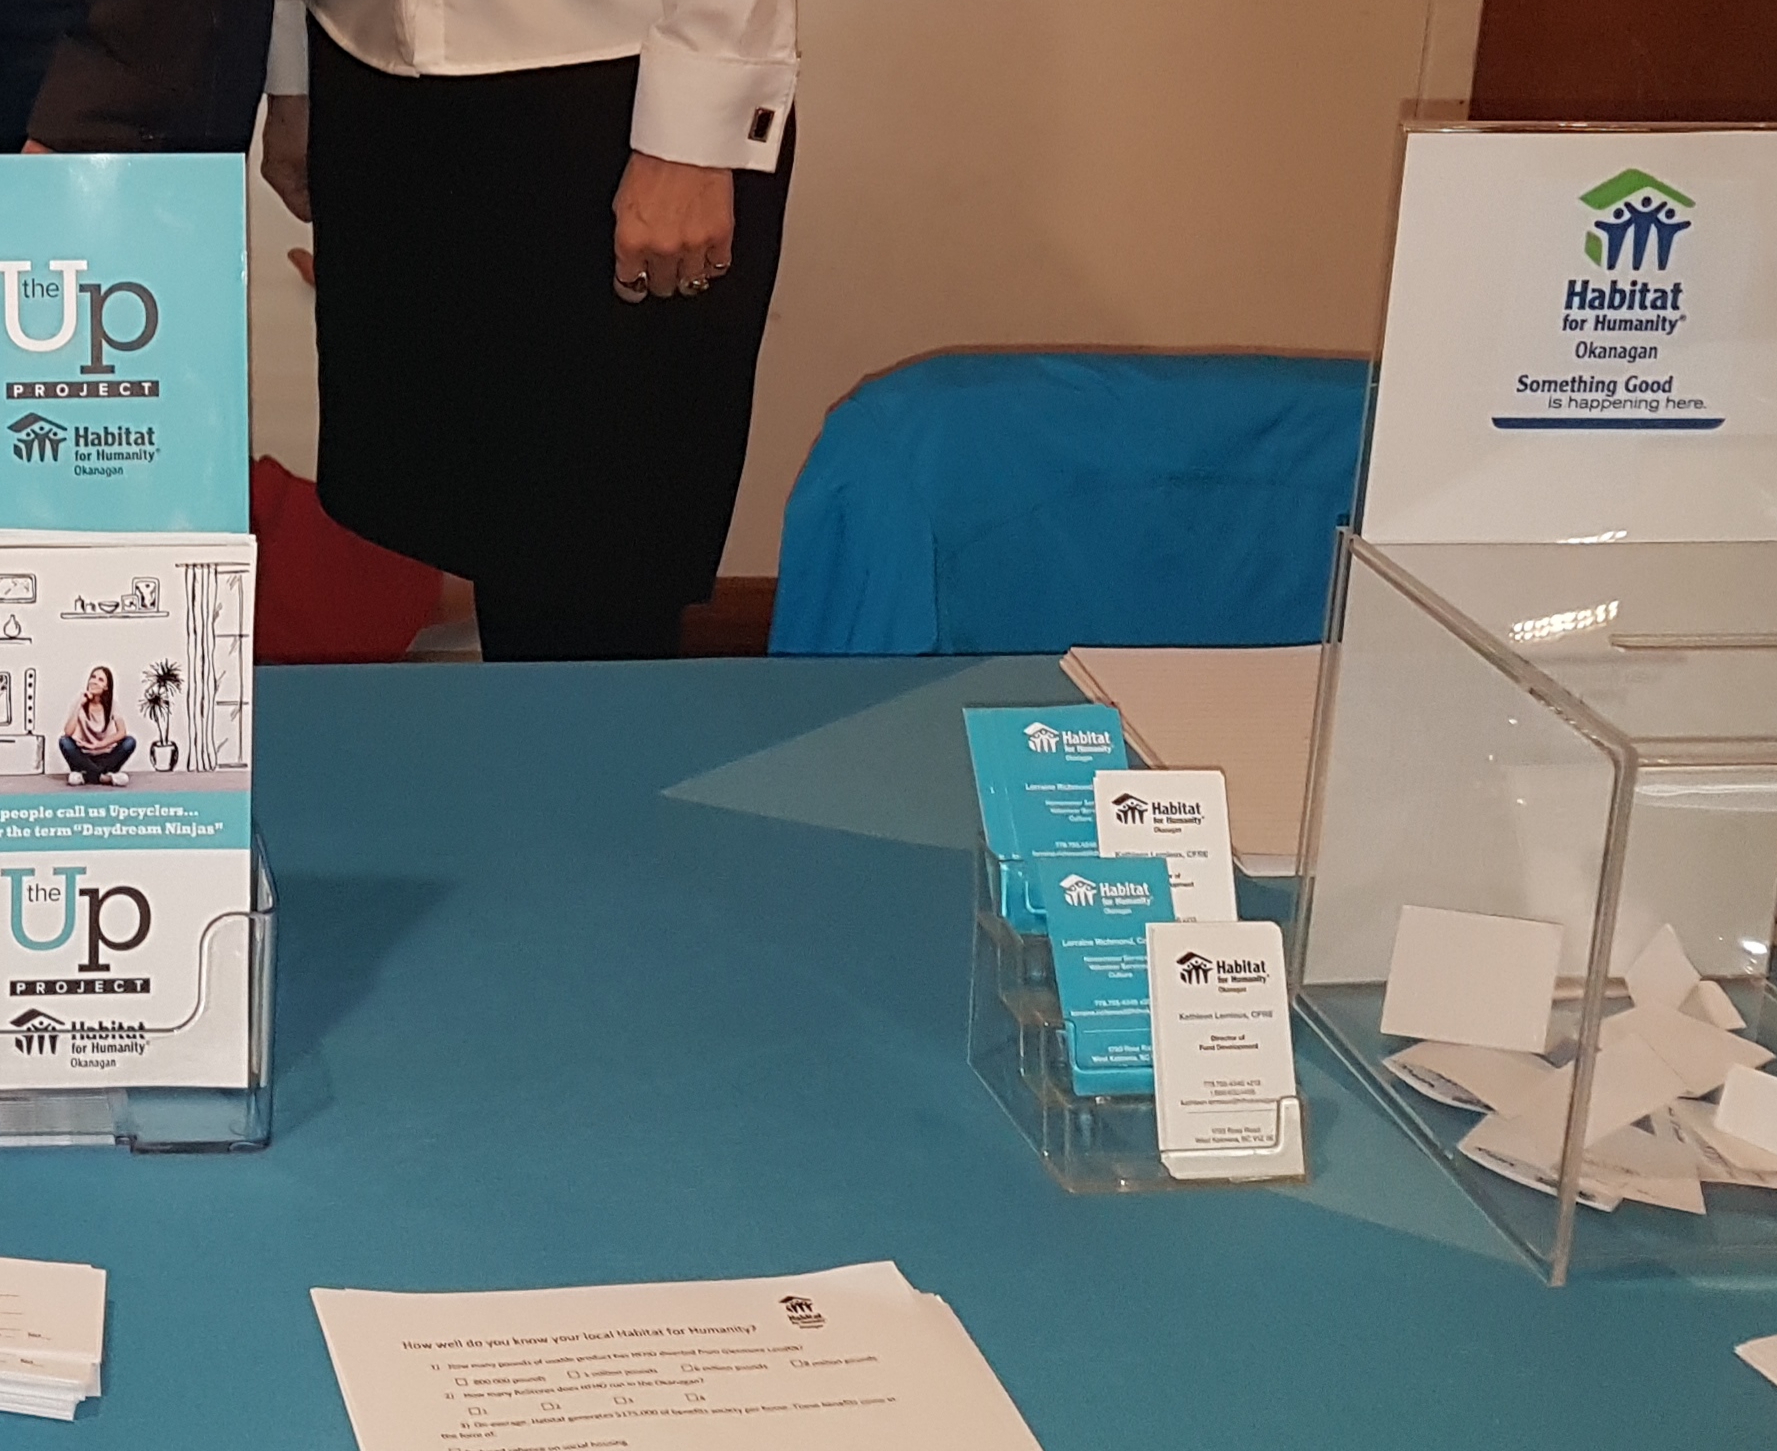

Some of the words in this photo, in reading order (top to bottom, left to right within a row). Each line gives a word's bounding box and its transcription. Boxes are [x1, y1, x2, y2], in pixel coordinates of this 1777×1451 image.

[22, 278, 60, 299] the
[1564, 280, 1683, 310] Habitat
[1562, 314, 1588, 332] for
[1575, 341, 1658, 362] Okanagan
[13, 382, 152, 398] PROJECT
[1516, 374, 1617, 396] Something
[1624, 376, 1673, 393] Good
[1548, 396, 1562, 409] is
[1568, 396, 1659, 412] happening
[1666, 396, 1707, 409] here.
[74, 426, 156, 447] Habitat
[74, 449, 93, 461] for
[74, 465, 124, 477] Okanagan
[0, 806, 53, 823] people
[57, 805, 85, 819] call
[88, 808, 106, 818] us
[1152, 802, 1201, 815] Habitat
[7, 826, 31, 838] the
[35, 826, 72, 838] term
[27, 884, 61, 902] the
[1099, 882, 1150, 897] Habitat
[0, 867, 151, 972] Up
[1216, 960, 1266, 974] Habitat
[16, 980, 144, 994] PROJECT
[71, 1021, 146, 1040] Habitat
[71, 1041, 88, 1055] for
[71, 1057, 117, 1069] Okanagan
[403, 1340, 432, 1350] How
[436, 1339, 462, 1349] well
[466, 1339, 482, 1348] do
[486, 1338, 510, 1349] you
[512, 1336, 548, 1346] know
[552, 1334, 580, 1344] your
[583, 1330, 613, 1340] local
[617, 1326, 663, 1338] Habitat
[666, 1326, 686, 1336] for
[690, 1325, 757, 1336] Humanity?
